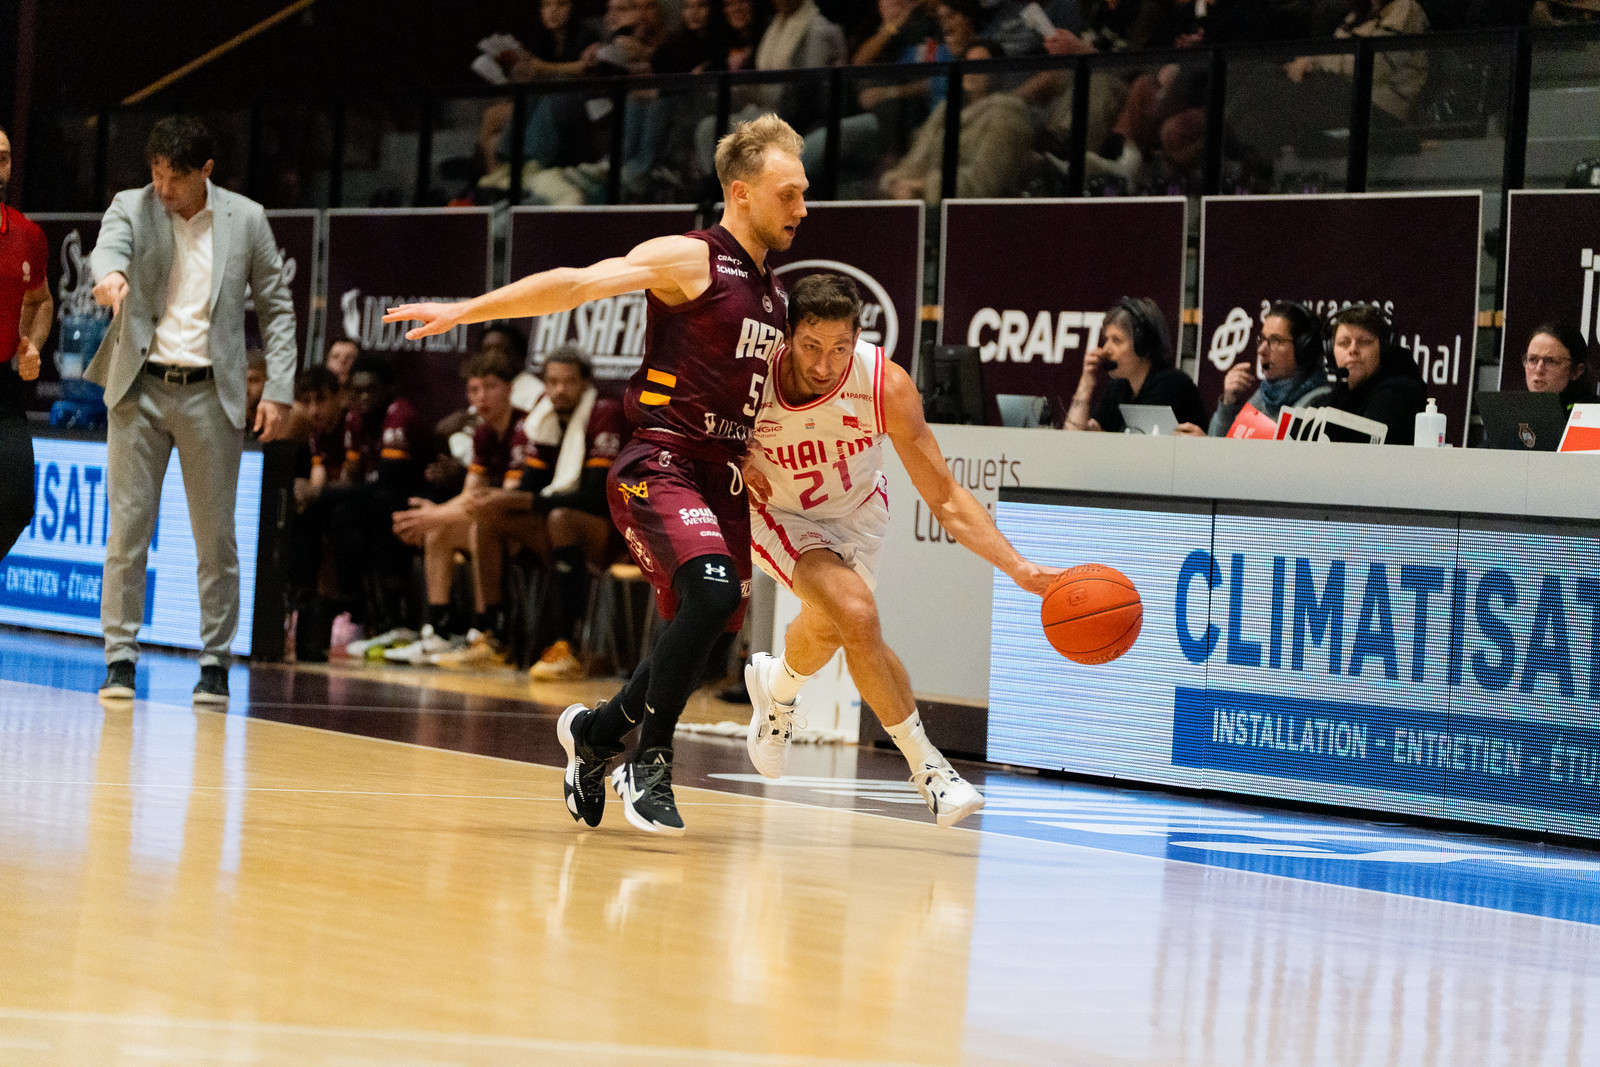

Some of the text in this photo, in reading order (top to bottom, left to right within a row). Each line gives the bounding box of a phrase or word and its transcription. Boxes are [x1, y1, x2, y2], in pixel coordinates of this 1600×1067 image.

[967, 307, 1106, 363] CRAFT
[743, 372, 764, 417] 5
[763, 436, 873, 471] CHALON
[793, 459, 853, 511] 21
[1175, 549, 1600, 700] CLIMATISAT
[1212, 707, 1367, 759] INSTALLATION
[1393, 726, 1522, 776] ENTRETIEN
